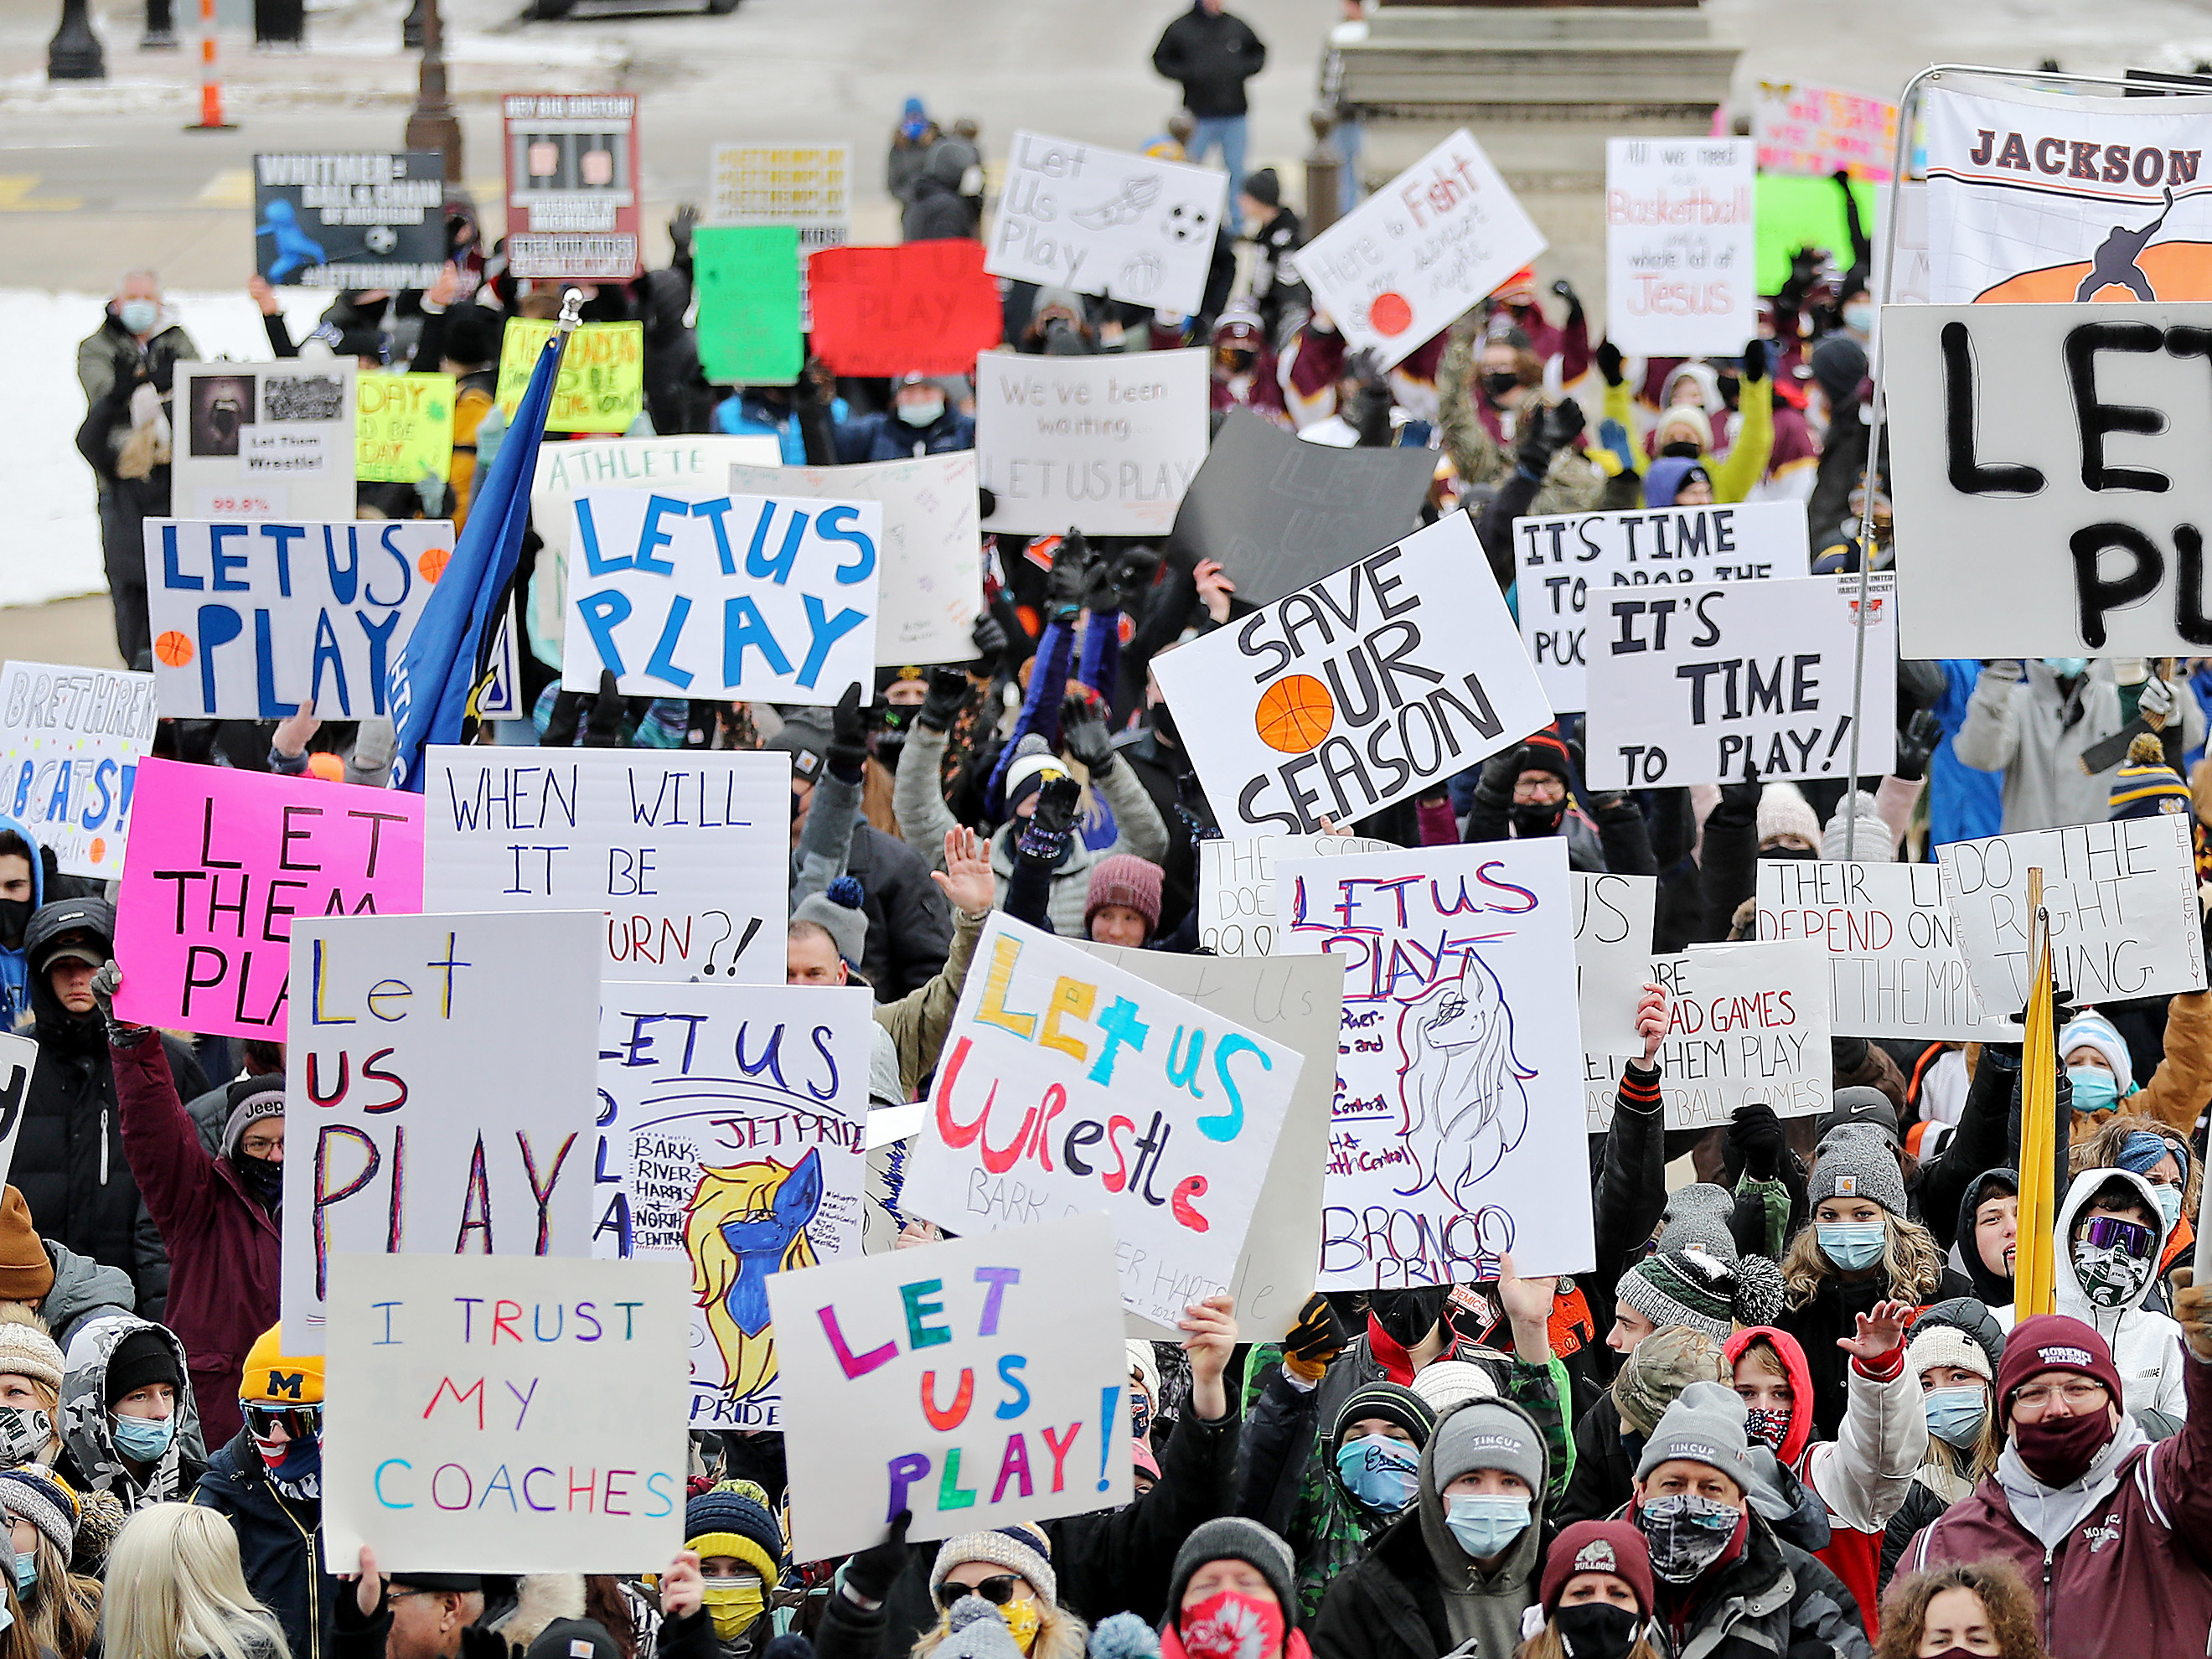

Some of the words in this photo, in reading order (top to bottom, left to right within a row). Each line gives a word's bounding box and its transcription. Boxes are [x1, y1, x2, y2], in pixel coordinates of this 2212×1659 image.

[1020, 136, 1087, 180] Let
[1969, 127, 2203, 188] JACKSON
[1606, 186, 1752, 226] Basketball
[997, 220, 1089, 290] Play
[855, 292, 960, 337] PLAY
[1626, 272, 1735, 318] Jesus
[1000, 375, 1092, 406] We've
[1109, 377, 1167, 406] been
[547, 448, 704, 492] ATHLETE
[984, 457, 1057, 499] LET
[1066, 460, 1113, 502] US
[1119, 457, 1196, 503] PLAY
[162, 525, 306, 597] LET
[323, 524, 411, 607] US
[574, 494, 737, 578] LET
[744, 499, 876, 587] US
[1522, 515, 1606, 566] IT'S
[1620, 509, 1736, 562] TIME
[576, 589, 869, 691] PLAY
[1237, 545, 1421, 684] SAVE
[1610, 591, 1726, 656] IT'S
[197, 603, 402, 717] PLAY
[1676, 653, 1822, 727] TIME
[1238, 653, 1506, 836] SEASON
[1619, 746, 1668, 786] TO
[1718, 714, 1853, 779] PLAY!
[445, 763, 579, 831] WHEN
[627, 766, 753, 830] WILL
[200, 796, 409, 879] LET
[1203, 835, 1276, 886] THE
[1954, 838, 2014, 896] DO
[2039, 818, 2158, 881] THE
[503, 845, 569, 897] IT
[607, 847, 659, 898] BE
[1290, 874, 1427, 937] LET
[1430, 861, 1539, 917] US
[1766, 861, 1874, 907] THEIR
[1758, 907, 1894, 953] DEPEND
[1907, 910, 1953, 951] ON
[312, 931, 473, 1026] Let
[1321, 928, 1450, 1002] PLAY
[972, 931, 1151, 1089] Let
[1710, 989, 1797, 1034] GAMES
[735, 1020, 840, 1101] US
[1740, 1030, 1810, 1079] PLAY
[245, 1101, 284, 1119] Jeep
[710, 1113, 790, 1149] JET
[793, 1113, 867, 1155] PRIDE
[634, 1136, 695, 1164] BARK
[638, 1159, 692, 1183] RIVER
[966, 1166, 1049, 1223] BARK
[1375, 1258, 1502, 1290] PRIDE
[370, 1301, 405, 1346] I
[453, 1297, 644, 1346] TRUST
[816, 1266, 1021, 1382] LET
[2037, 1346, 2093, 1364] MORENCI
[266, 1370, 305, 1399] M
[422, 1376, 540, 1432] MY
[689, 1393, 780, 1426] PRIDE
[922, 1353, 1031, 1432] US
[885, 1386, 1122, 1525] PLAY!
[1473, 1434, 1522, 1449] TINCUP
[1668, 1442, 1715, 1455] TINCUP
[374, 1458, 674, 1519] COACHES
[1574, 1562, 1616, 1573] BULLDOGS
